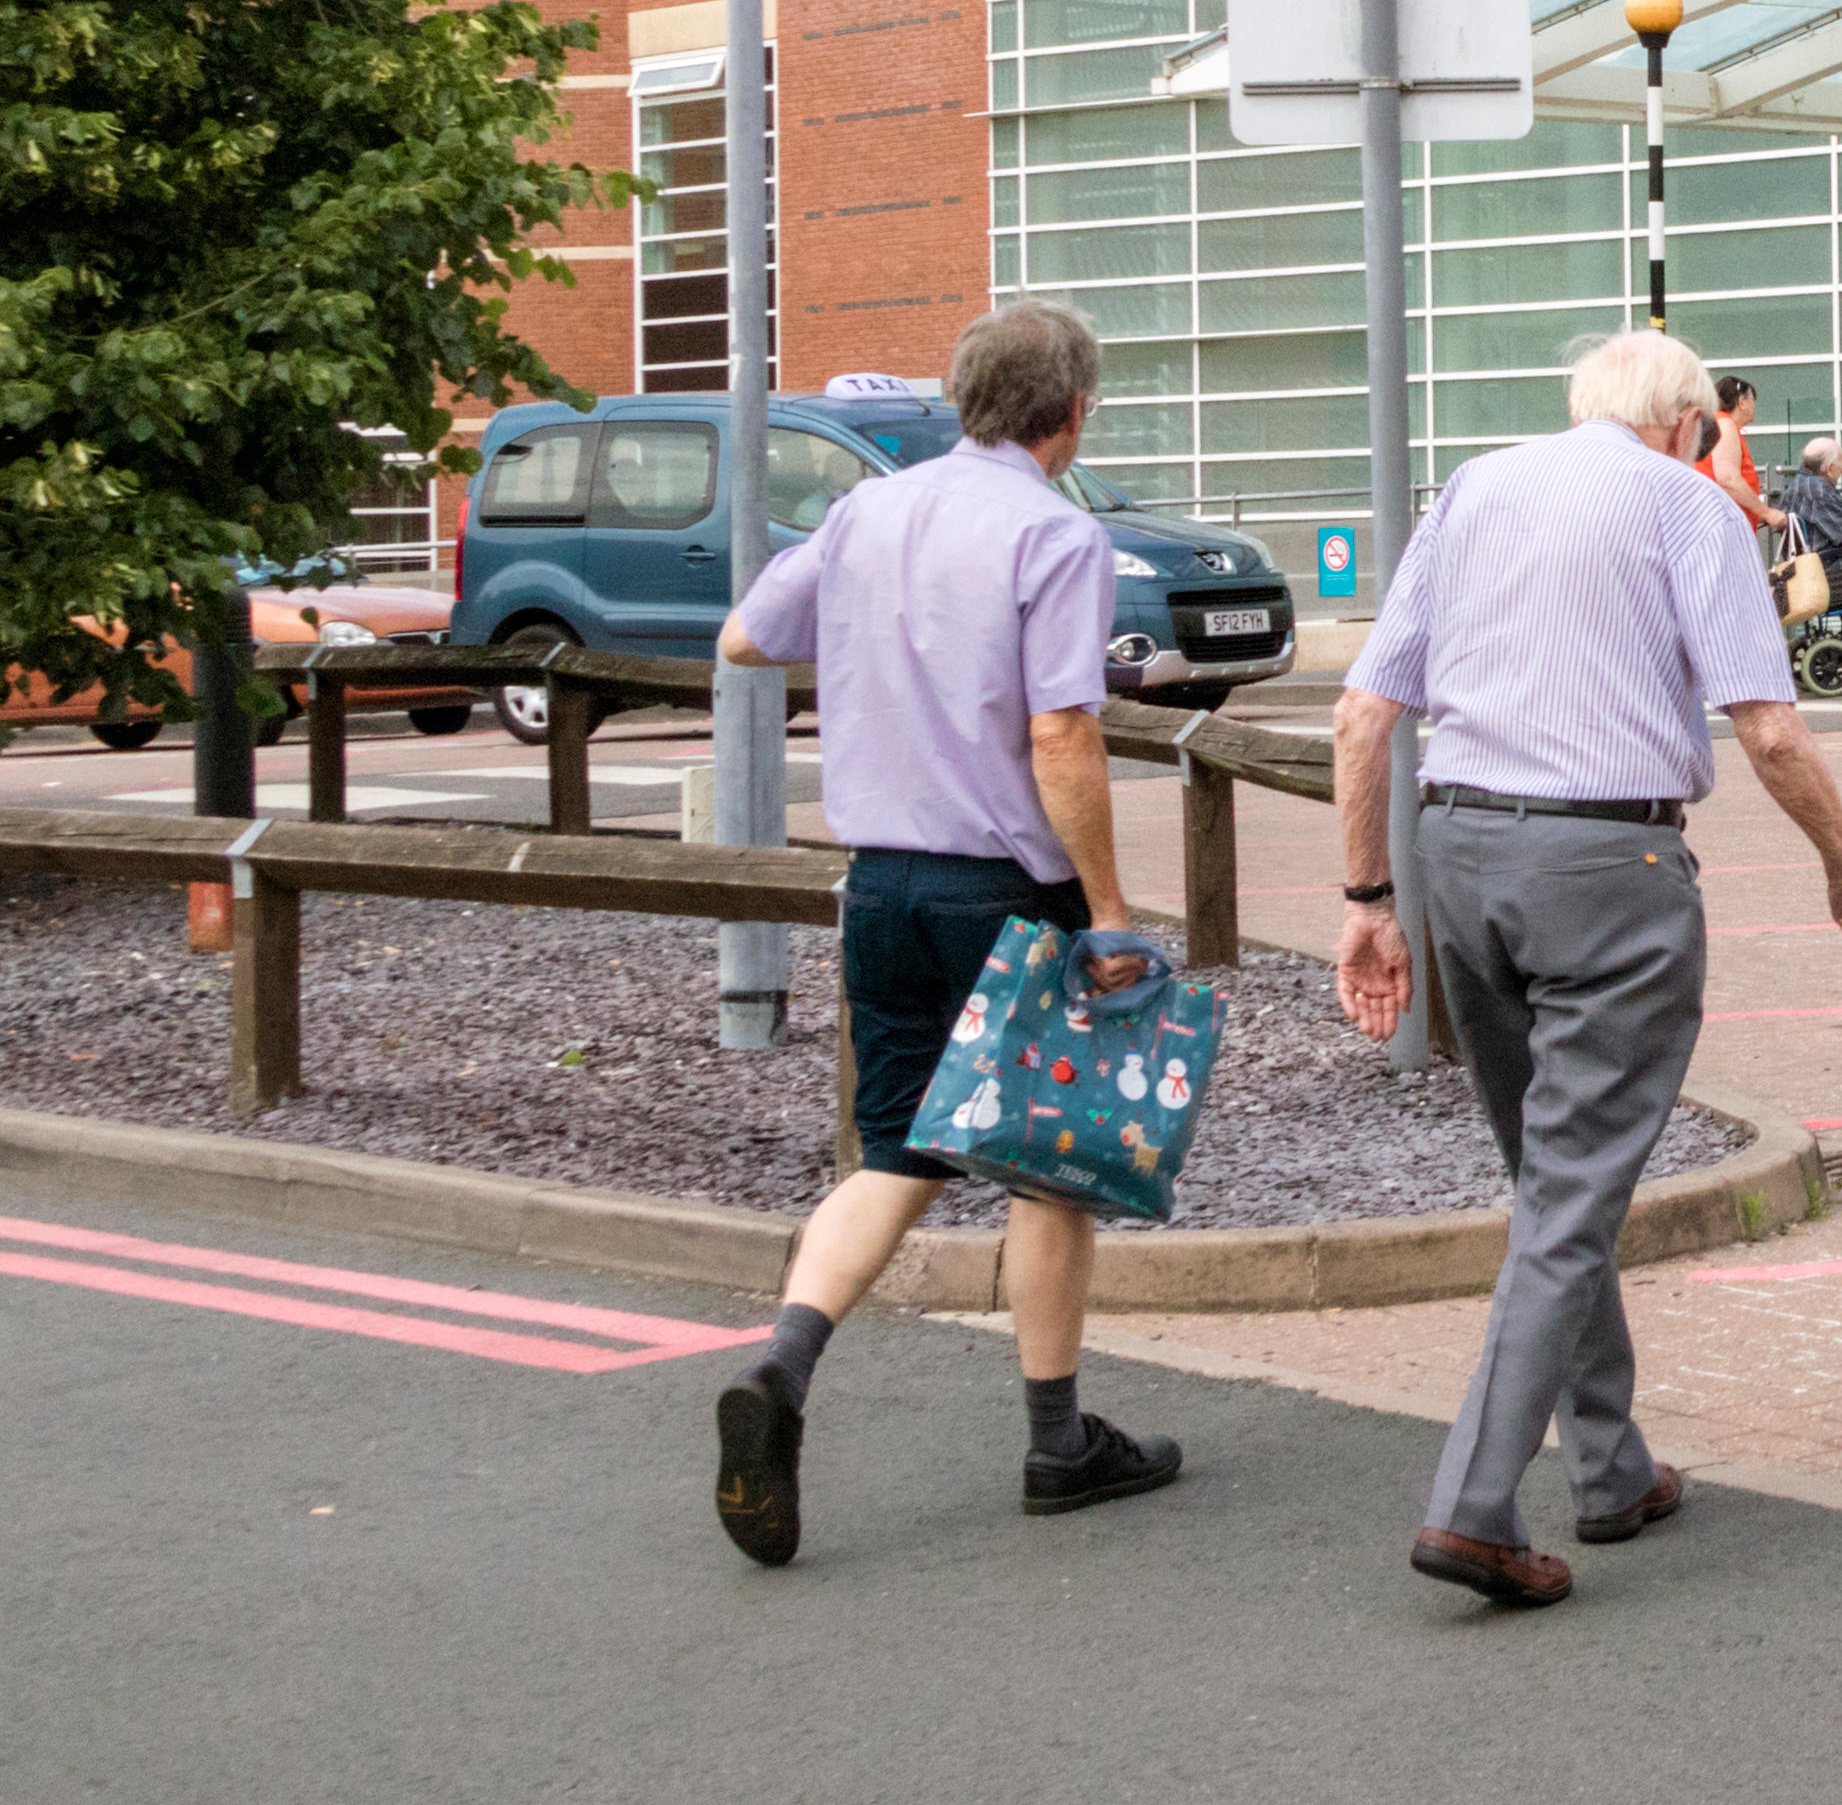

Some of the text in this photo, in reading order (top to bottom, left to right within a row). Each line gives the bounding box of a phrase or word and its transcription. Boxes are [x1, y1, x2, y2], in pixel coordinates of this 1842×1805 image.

[846, 378, 911, 392] TAXI
[1213, 611, 1264, 632] SF12 FYH
